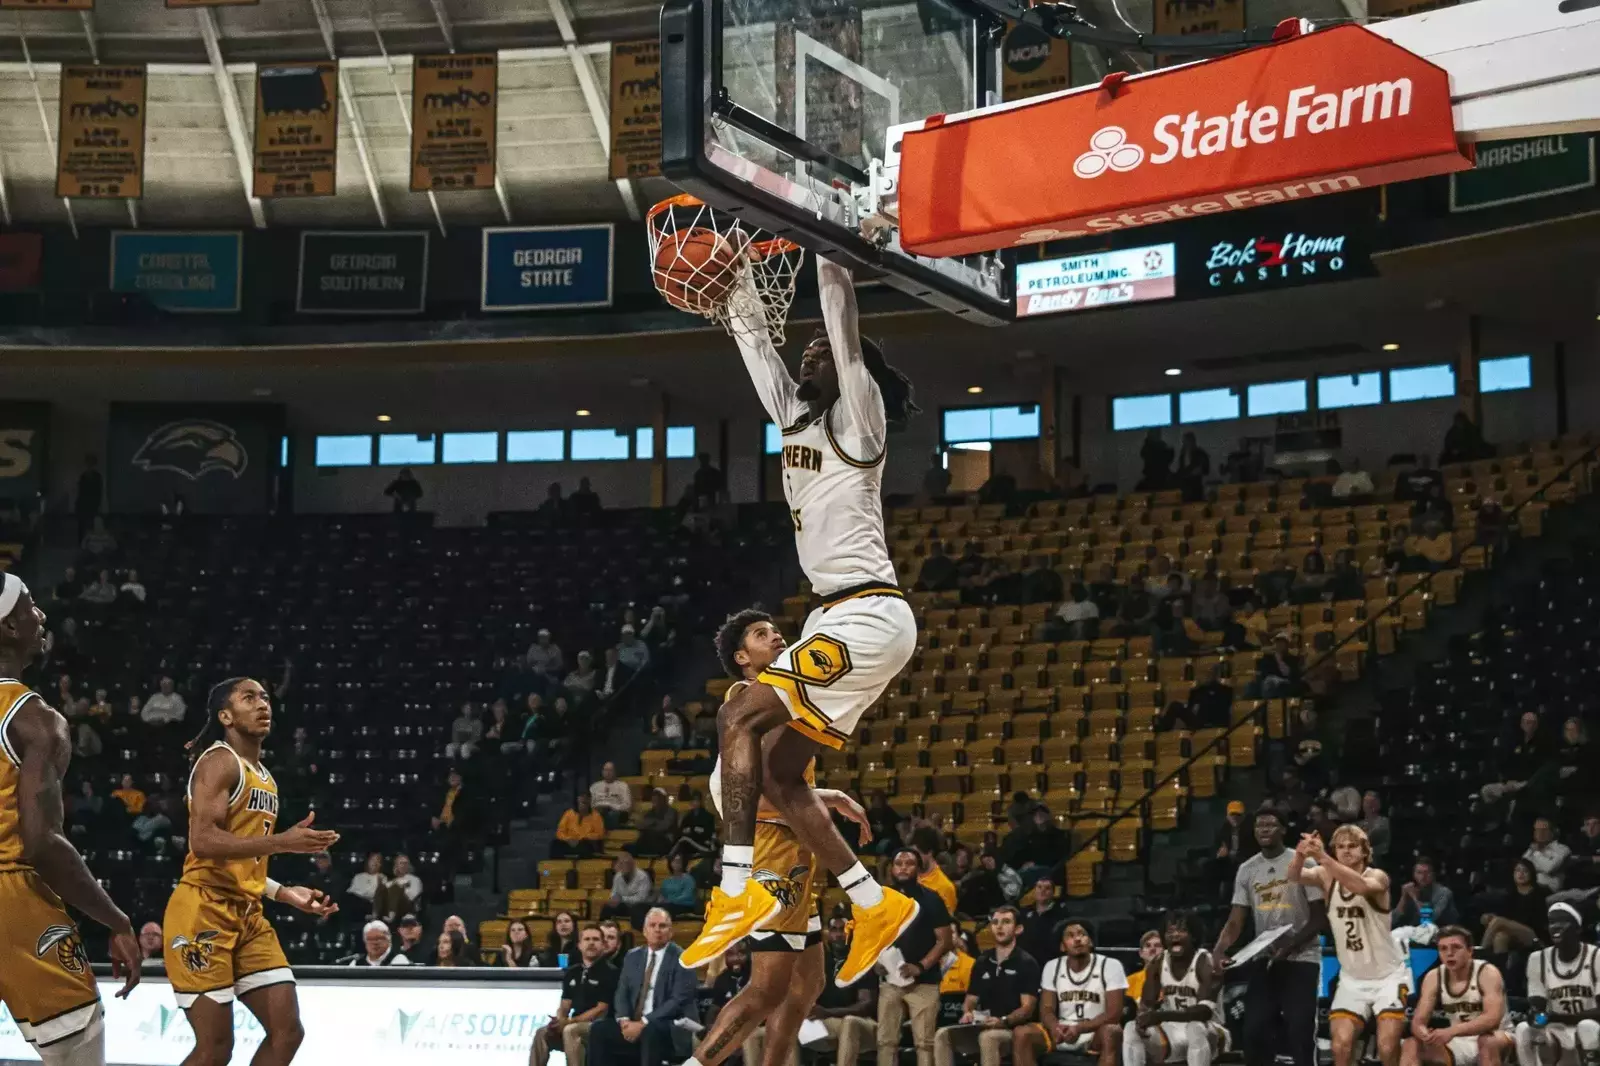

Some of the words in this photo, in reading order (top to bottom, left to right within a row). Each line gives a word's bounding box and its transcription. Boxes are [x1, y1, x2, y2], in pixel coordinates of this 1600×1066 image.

[1008, 43, 1051, 64] NCAA
[513, 247, 582, 267] GEORGIA
[1205, 237, 1257, 270] Bok
[1279, 232, 1346, 259] Homa
[330, 253, 398, 271] GEORGIA
[1060, 257, 1099, 273] SMITH
[520, 268, 574, 288] STATE
[1208, 256, 1344, 287] CASINO
[320, 273, 405, 291] SOUTHERN
[1344, 921, 1357, 939] 2
[1075, 1003, 1084, 1019] 0
[1559, 999, 1584, 1014] 30
